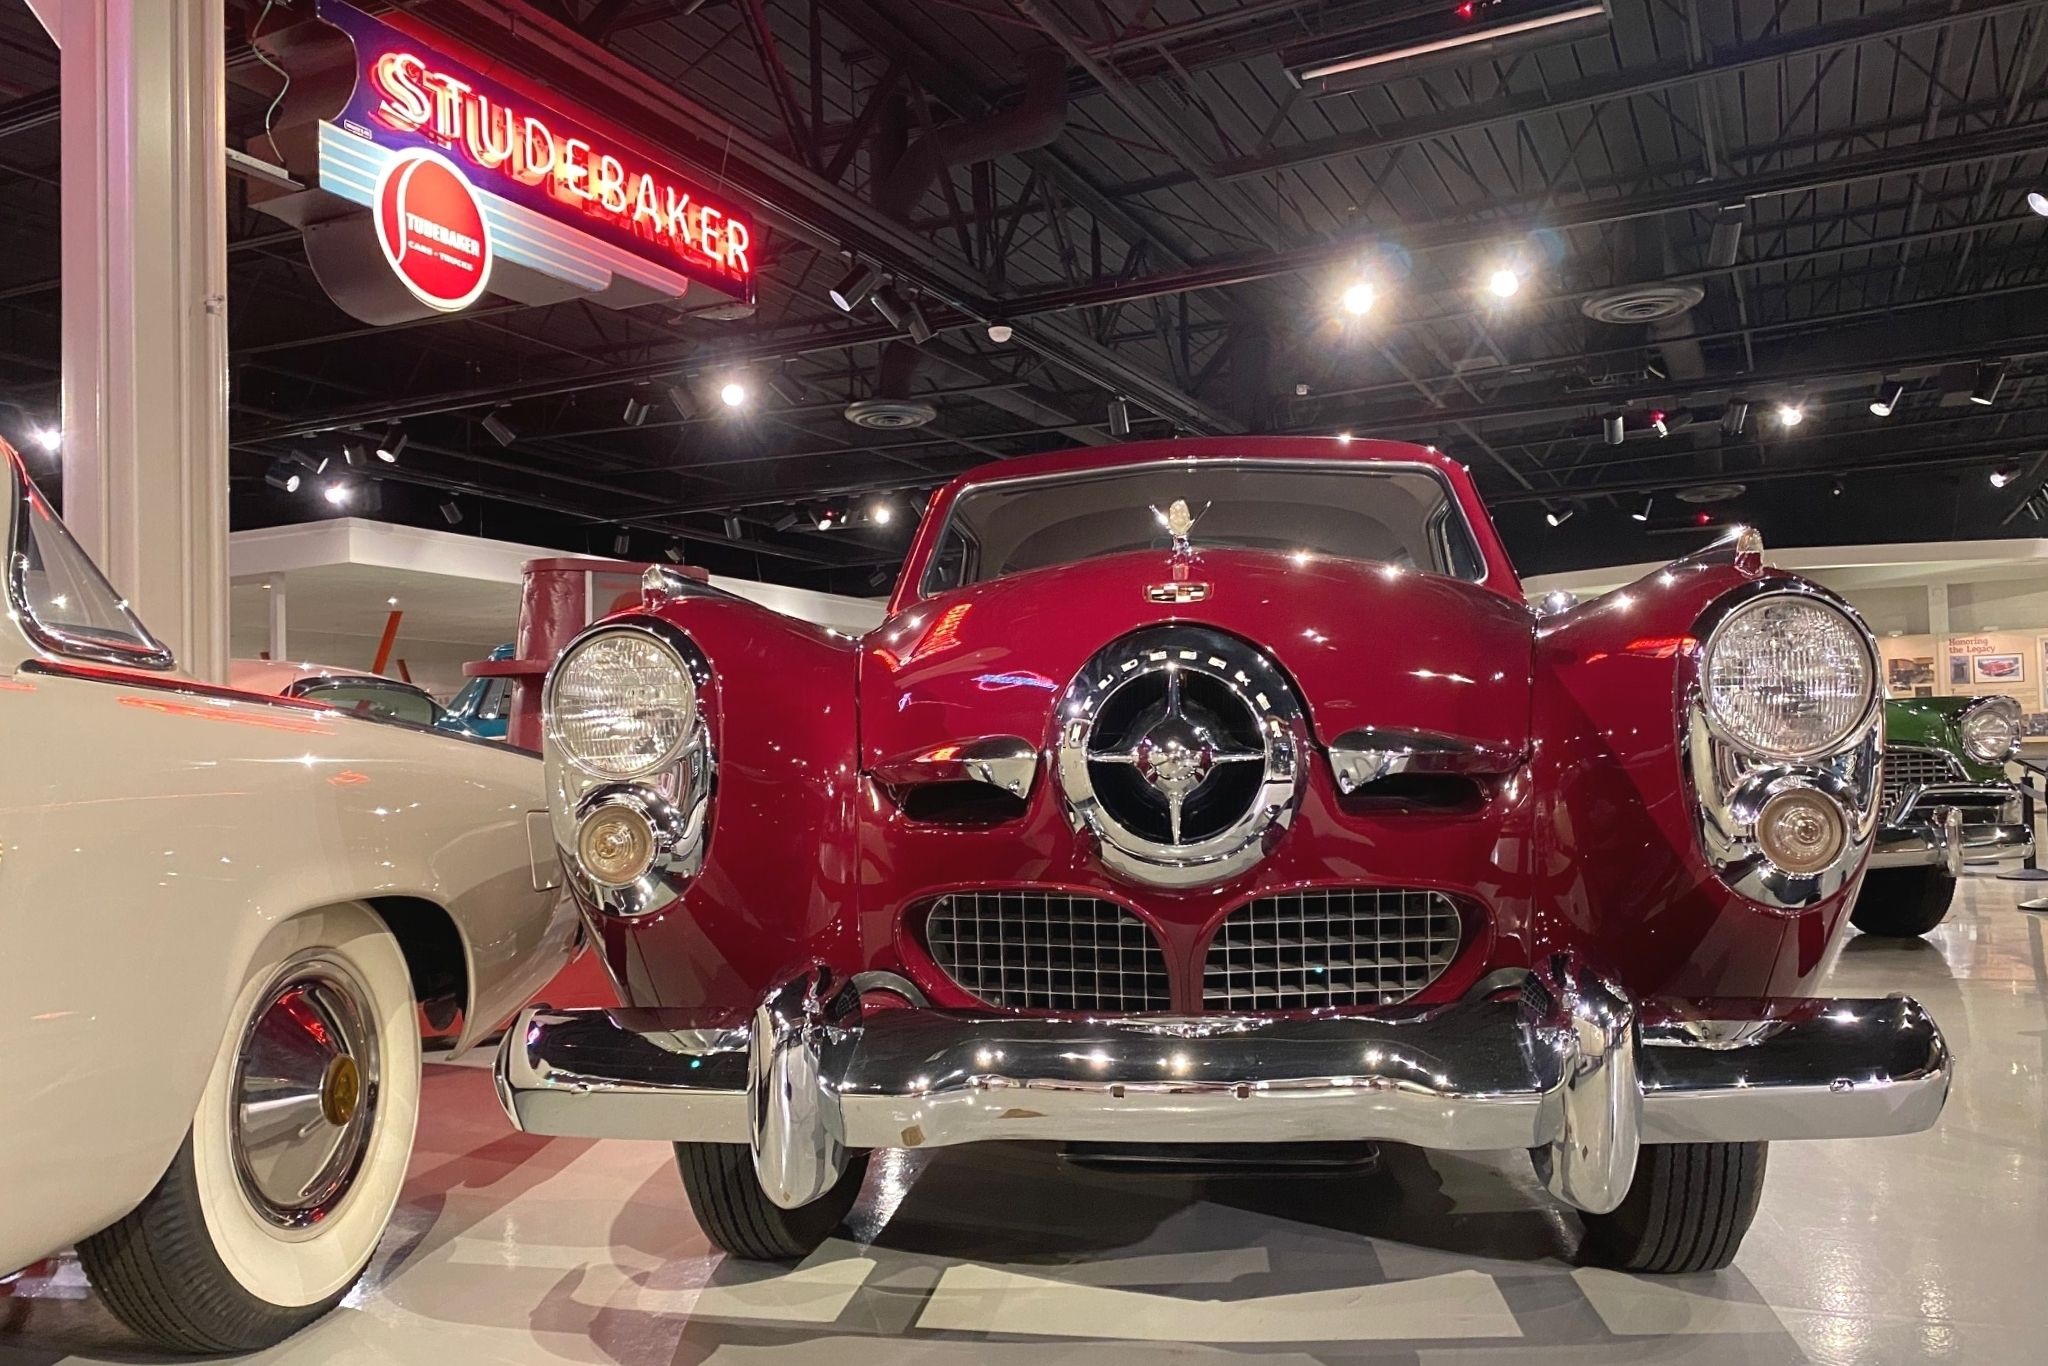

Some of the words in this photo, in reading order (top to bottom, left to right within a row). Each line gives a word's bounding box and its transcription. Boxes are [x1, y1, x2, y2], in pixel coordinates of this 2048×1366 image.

[368, 53, 749, 281] STUDEBAKER
[1949, 637, 1988, 646] Honoring
[1949, 646, 1963, 654] the
[1967, 645, 1995, 654] Legacy
